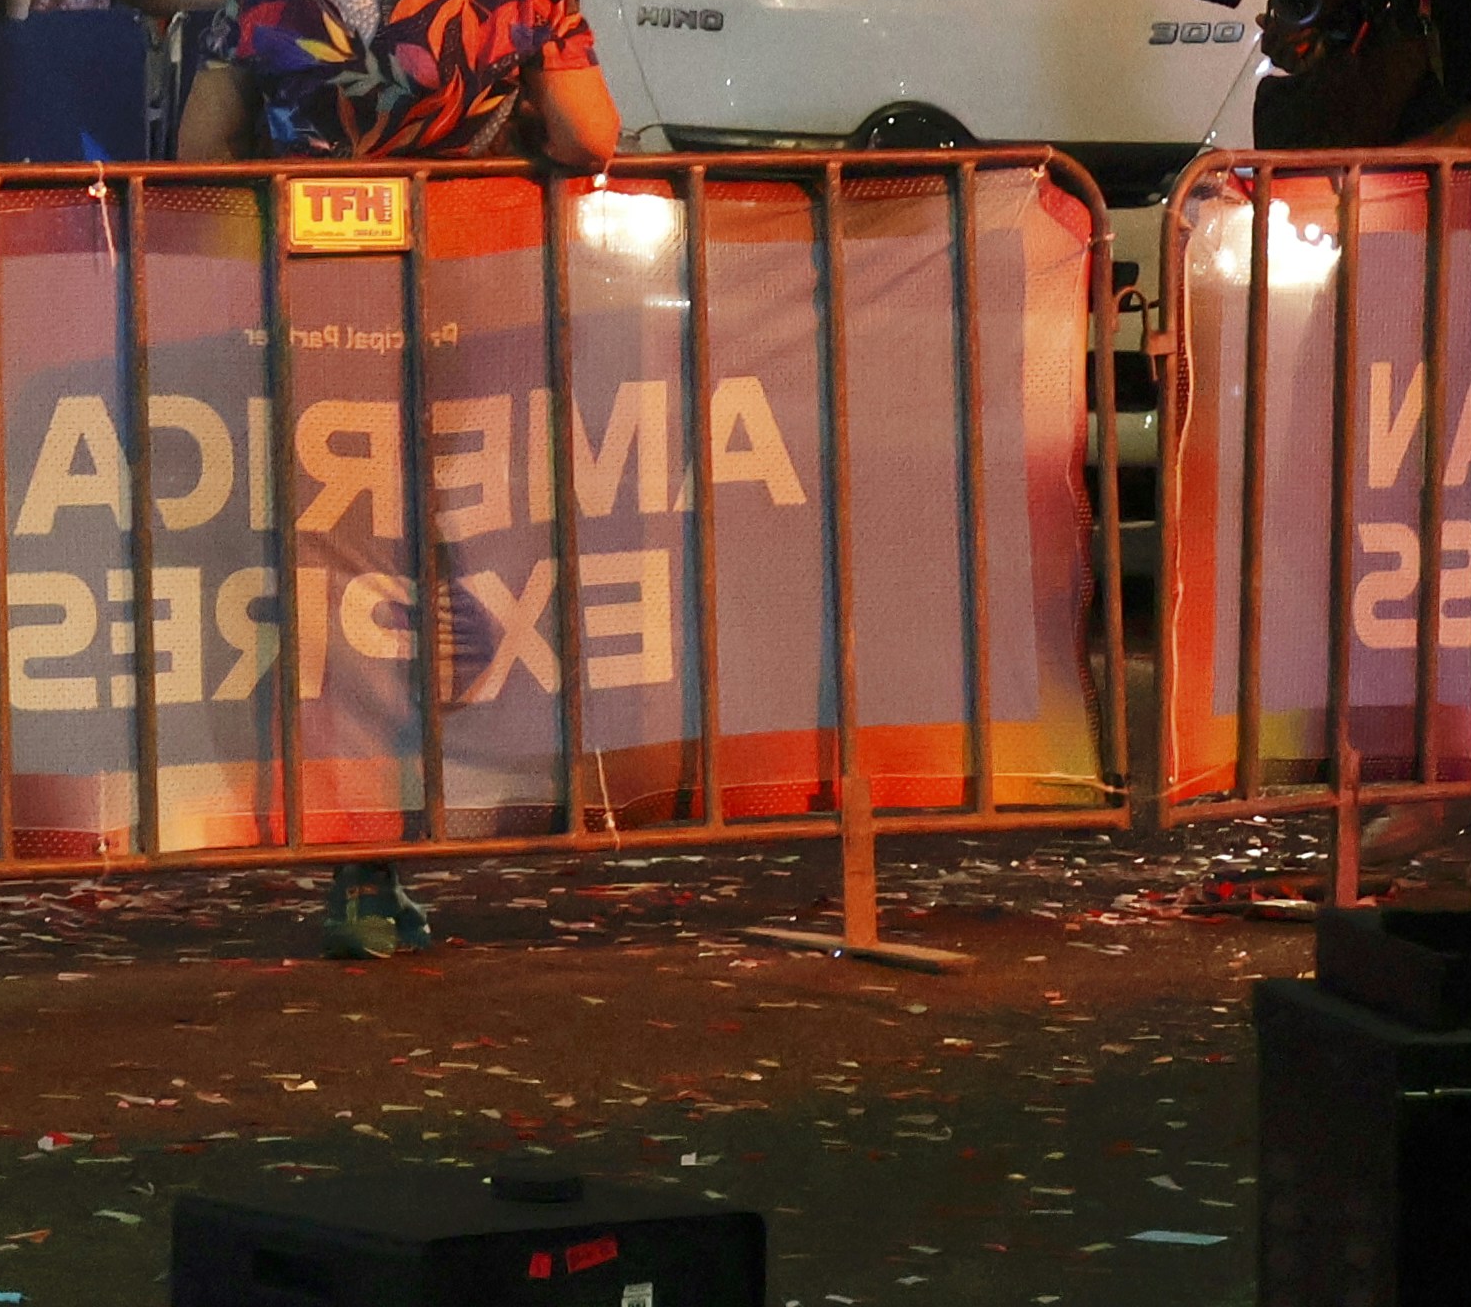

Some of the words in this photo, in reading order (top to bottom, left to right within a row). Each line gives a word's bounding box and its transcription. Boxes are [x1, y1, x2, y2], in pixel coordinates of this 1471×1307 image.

[637, 6, 724, 32] HINO
[1148, 22, 1245, 45] 300
[303, 185, 383, 223] TFH
